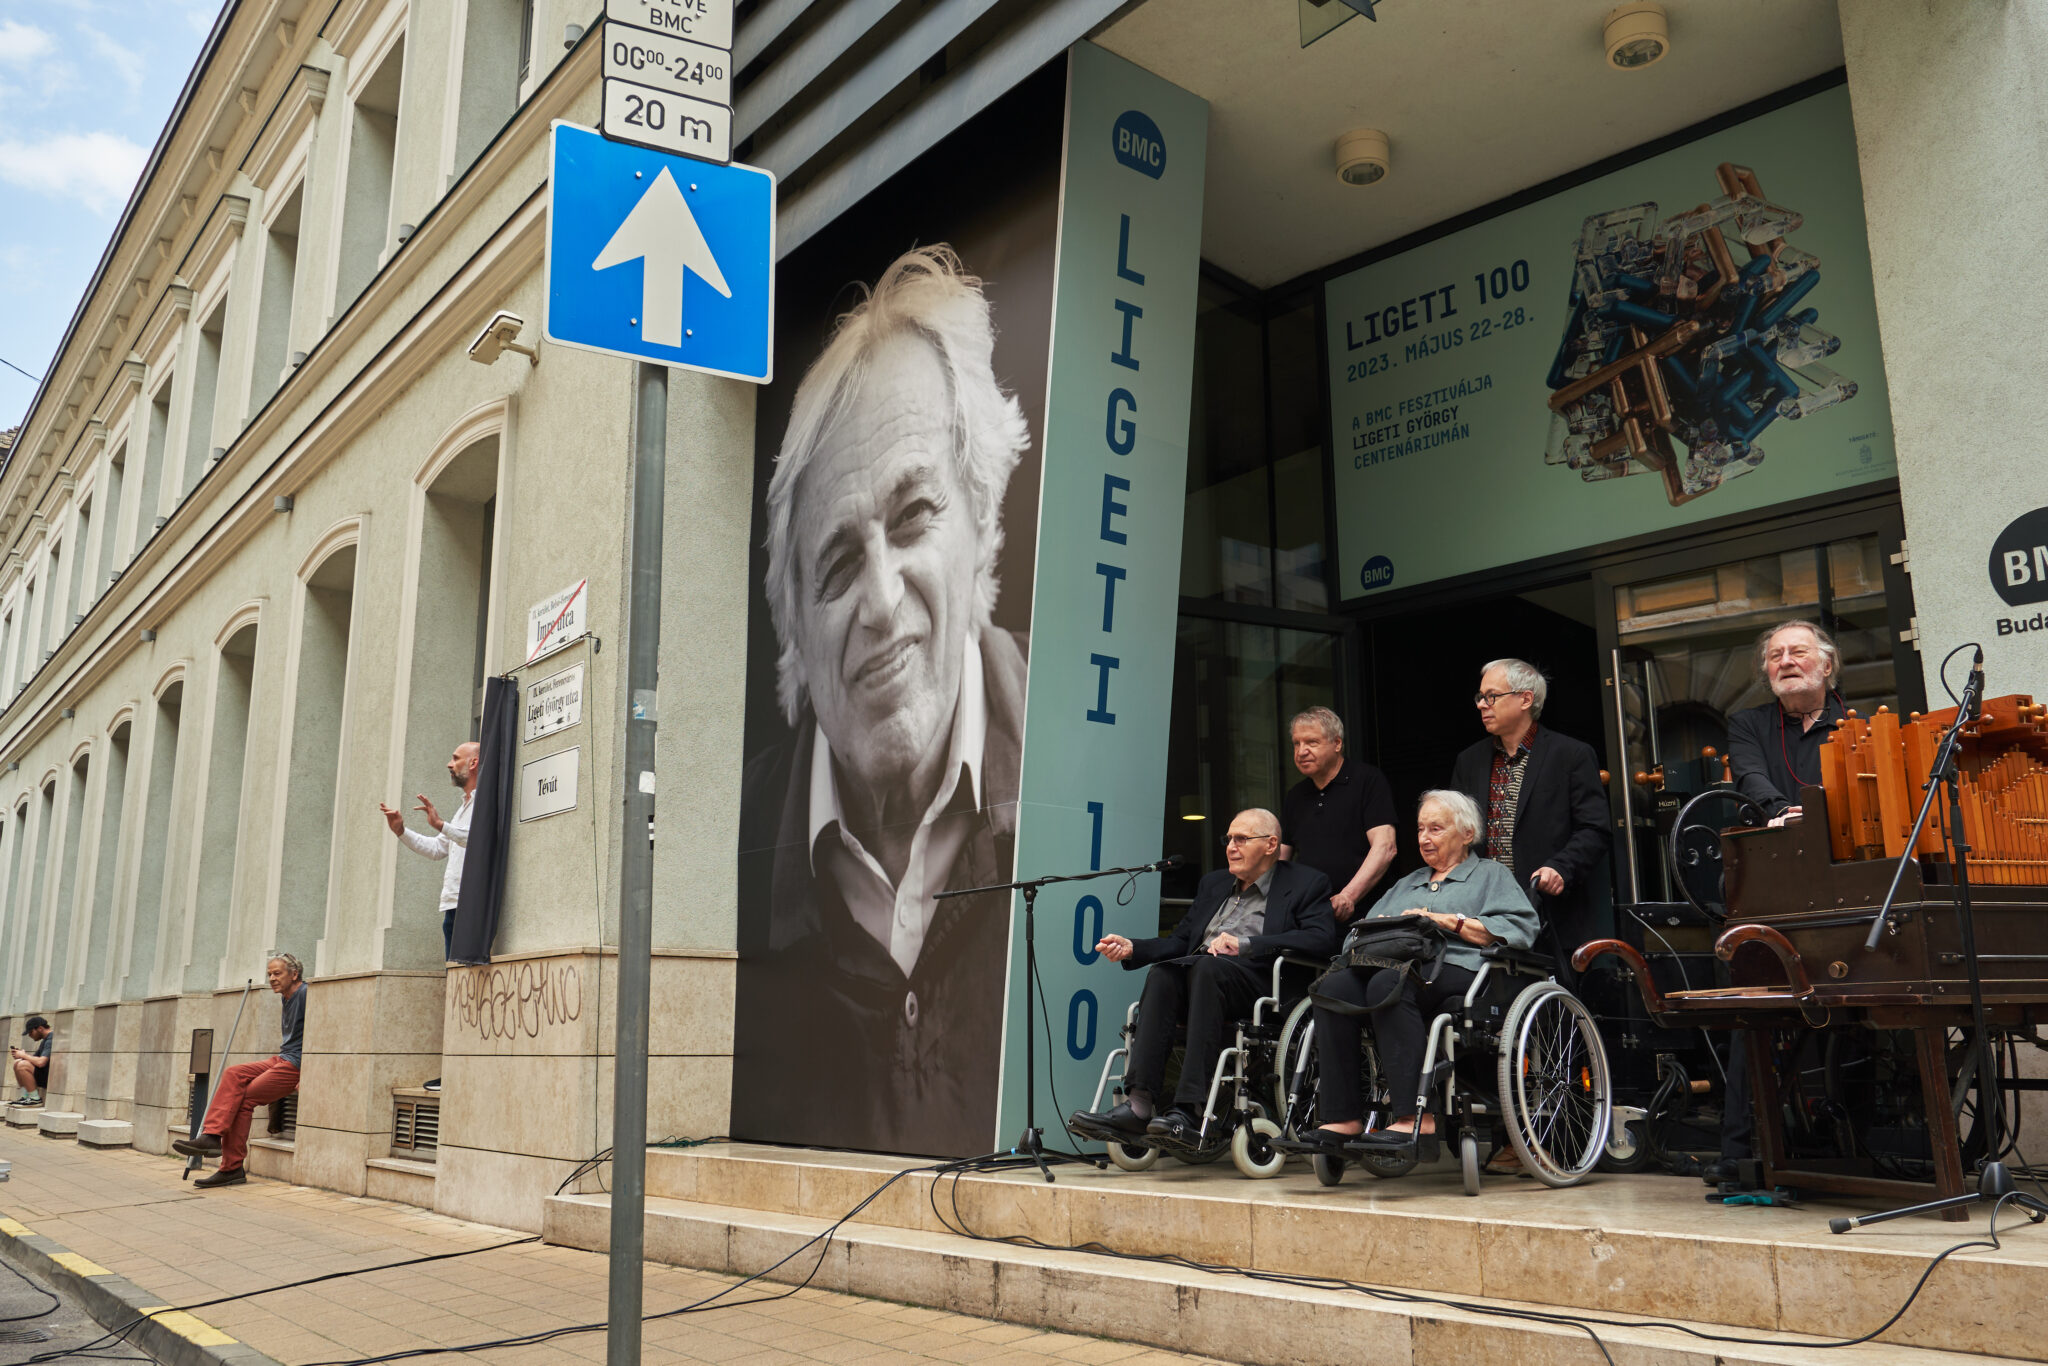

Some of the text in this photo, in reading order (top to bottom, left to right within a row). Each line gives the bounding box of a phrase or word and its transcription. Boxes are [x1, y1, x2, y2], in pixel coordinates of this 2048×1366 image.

[650, 8, 693, 34] BMC
[624, 94, 712, 143] 20 m
[1119, 127, 1161, 167] BMC
[1346, 259, 1530, 351] LIGETI 100
[1347, 307, 1534, 383] 2023. MÁJUS 22-28.
[1352, 374, 1493, 431] A BMC FESZTIVÁLJA
[1353, 405, 1459, 450] LIGETI GYÖRGY
[1354, 423, 1470, 471] CENTENÁRIUMÁN
[1364, 566, 1391, 584] BMC
[1066, 213, 1146, 1061] LIGETI 100
[1996, 612, 2048, 636] Bud
[528, 690, 579, 723] Ligeti György utca
[537, 775, 558, 797] Tévút
